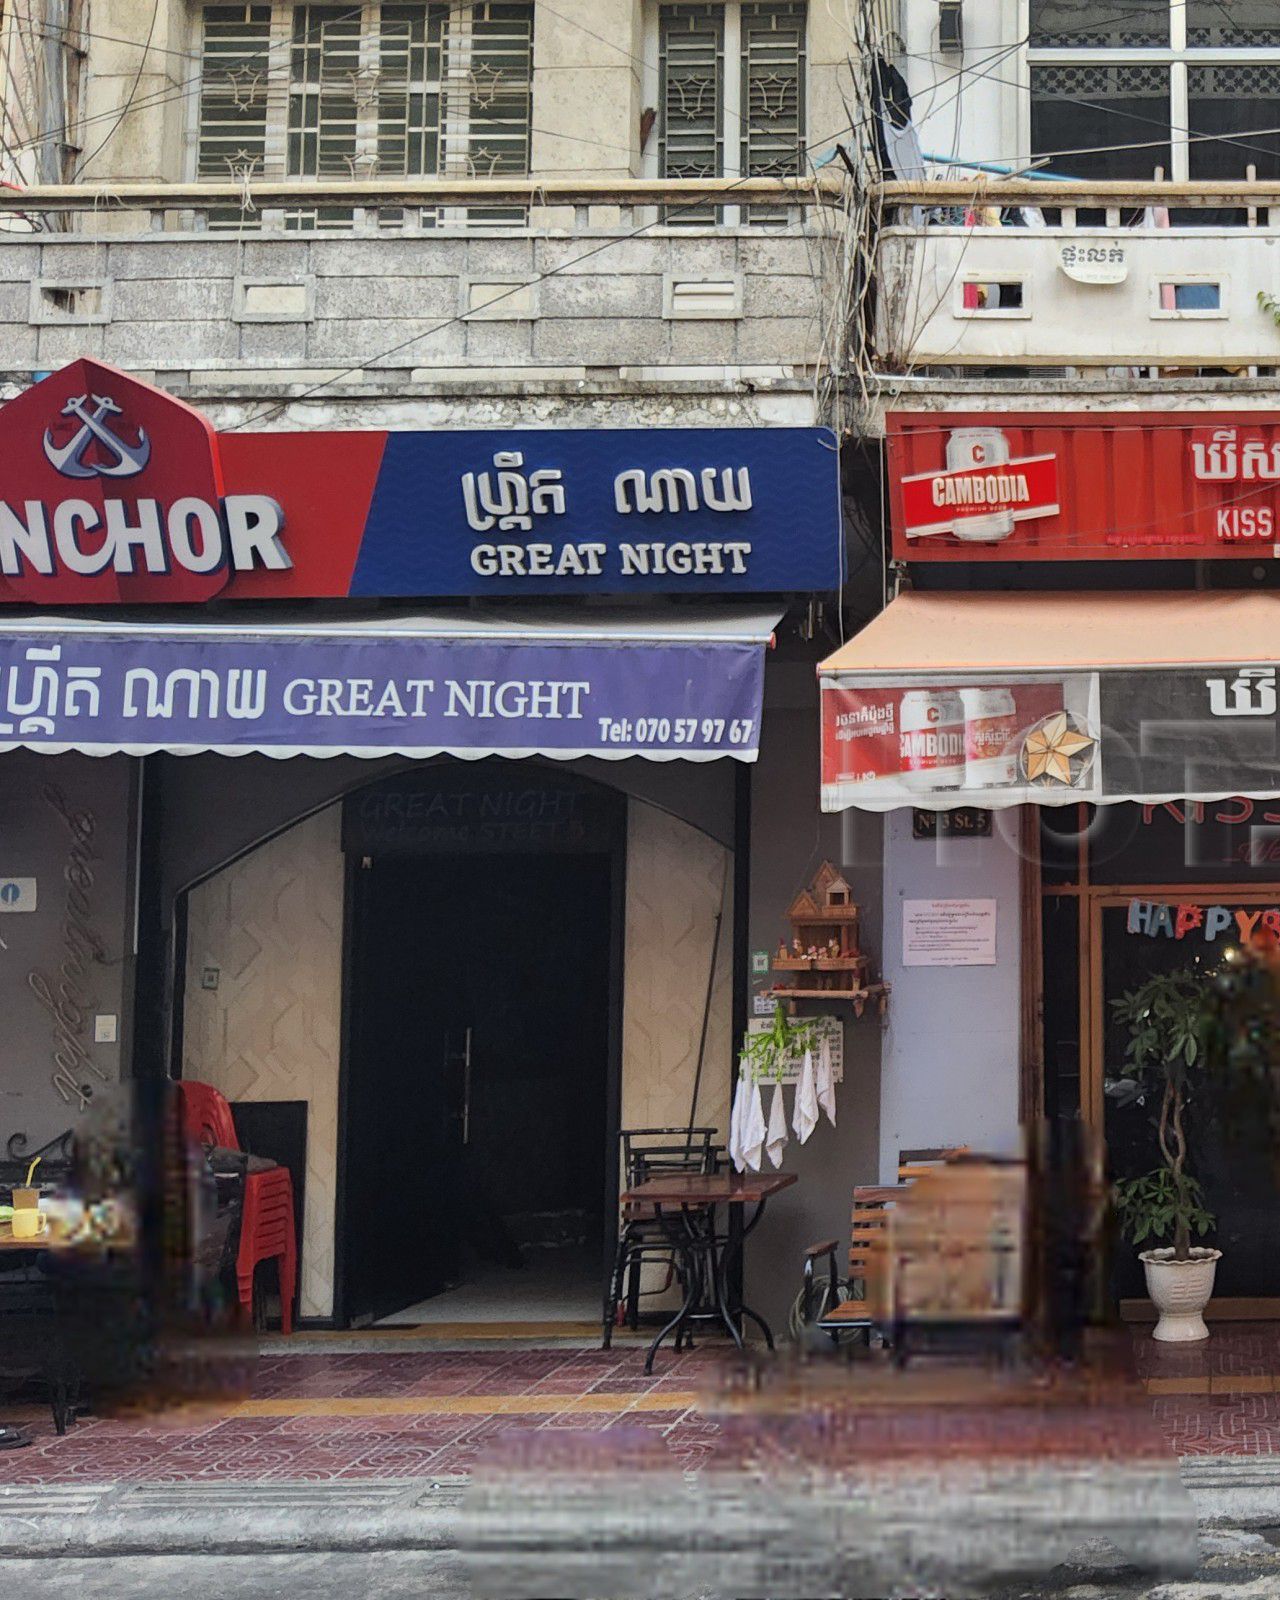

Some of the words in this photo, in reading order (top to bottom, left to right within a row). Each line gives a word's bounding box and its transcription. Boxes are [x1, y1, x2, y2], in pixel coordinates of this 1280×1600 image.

[931, 475, 1029, 507] CAMBODIA
[1217, 508, 1273, 537] KISS
[470, 542, 606, 576] GREAT
[619, 541, 752, 575] NIGHT
[283, 678, 434, 718] GREAT
[444, 680, 590, 719] NIGHT
[599, 718, 633, 742] Tel:
[636, 719, 670, 743] 070
[674, 719, 697, 743] 57
[702, 720, 726, 743] 97
[729, 720, 754, 744] 67
[942, 814, 950, 829] 3
[955, 813, 974, 829] St.
[977, 814, 986, 828] 5
[1127, 896, 1262, 944] HAPPY
